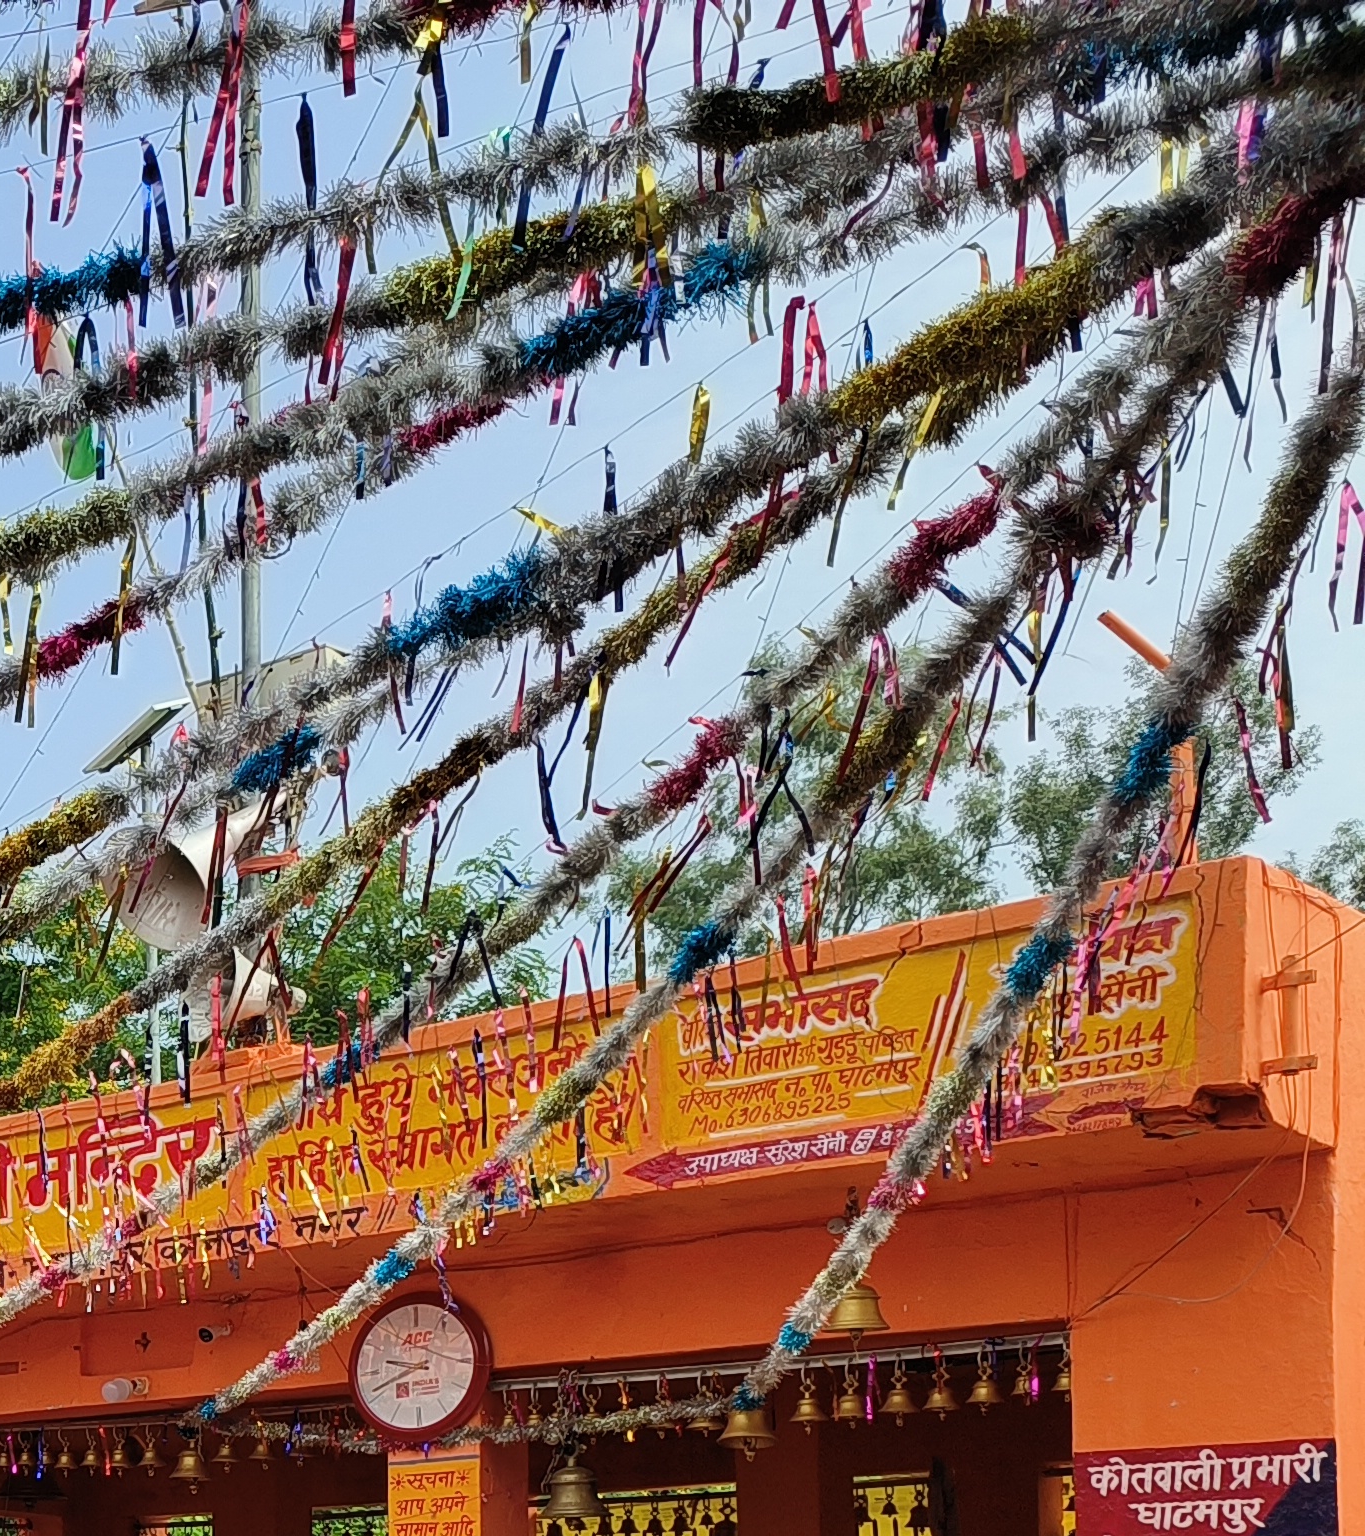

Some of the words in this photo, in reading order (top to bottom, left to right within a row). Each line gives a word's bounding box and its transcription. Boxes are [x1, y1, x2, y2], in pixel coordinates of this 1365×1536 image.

[723, 1077, 777, 1107] सभासद
[401, 1329, 435, 1347] ACC
[404, 1470, 456, 1493] सूचना
[1087, 1448, 1226, 1497] कोतवाली
[1225, 1442, 1329, 1491] प्रभारी
[394, 1498, 427, 1517] आप
[430, 1490, 470, 1514] अपने
[1127, 1497, 1266, 1535] घाटमपुर
